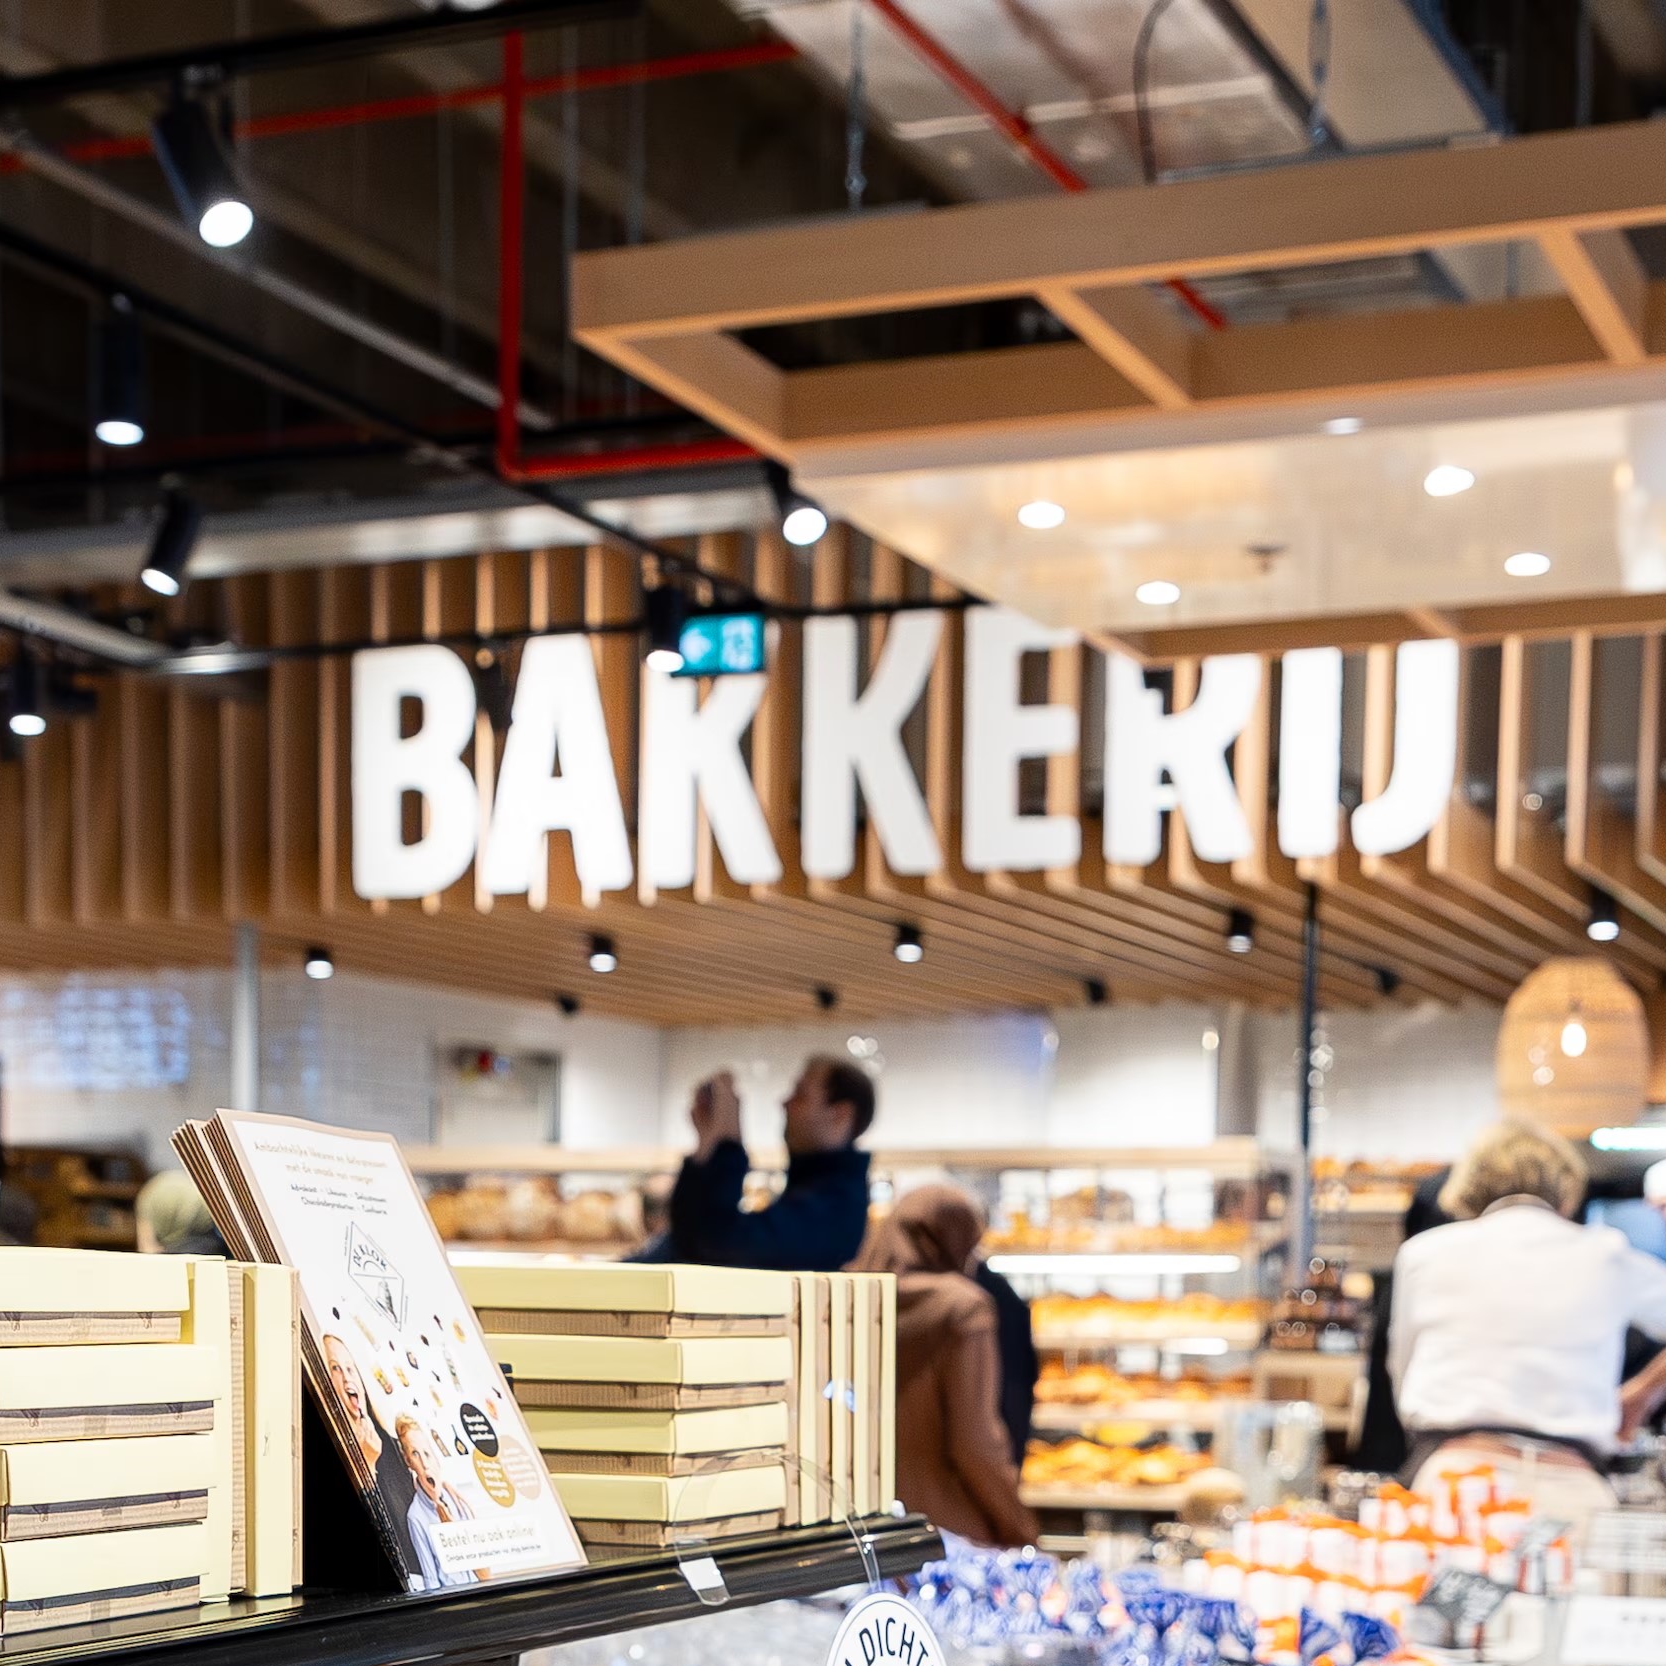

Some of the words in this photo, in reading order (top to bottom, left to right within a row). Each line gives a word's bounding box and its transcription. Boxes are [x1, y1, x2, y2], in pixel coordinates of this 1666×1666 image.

[351, 607, 1459, 900] BAKKERIJ
[439, 1528, 470, 1548] Bestel
[473, 1534, 485, 1543] nu
[488, 1527, 504, 1541] ook
